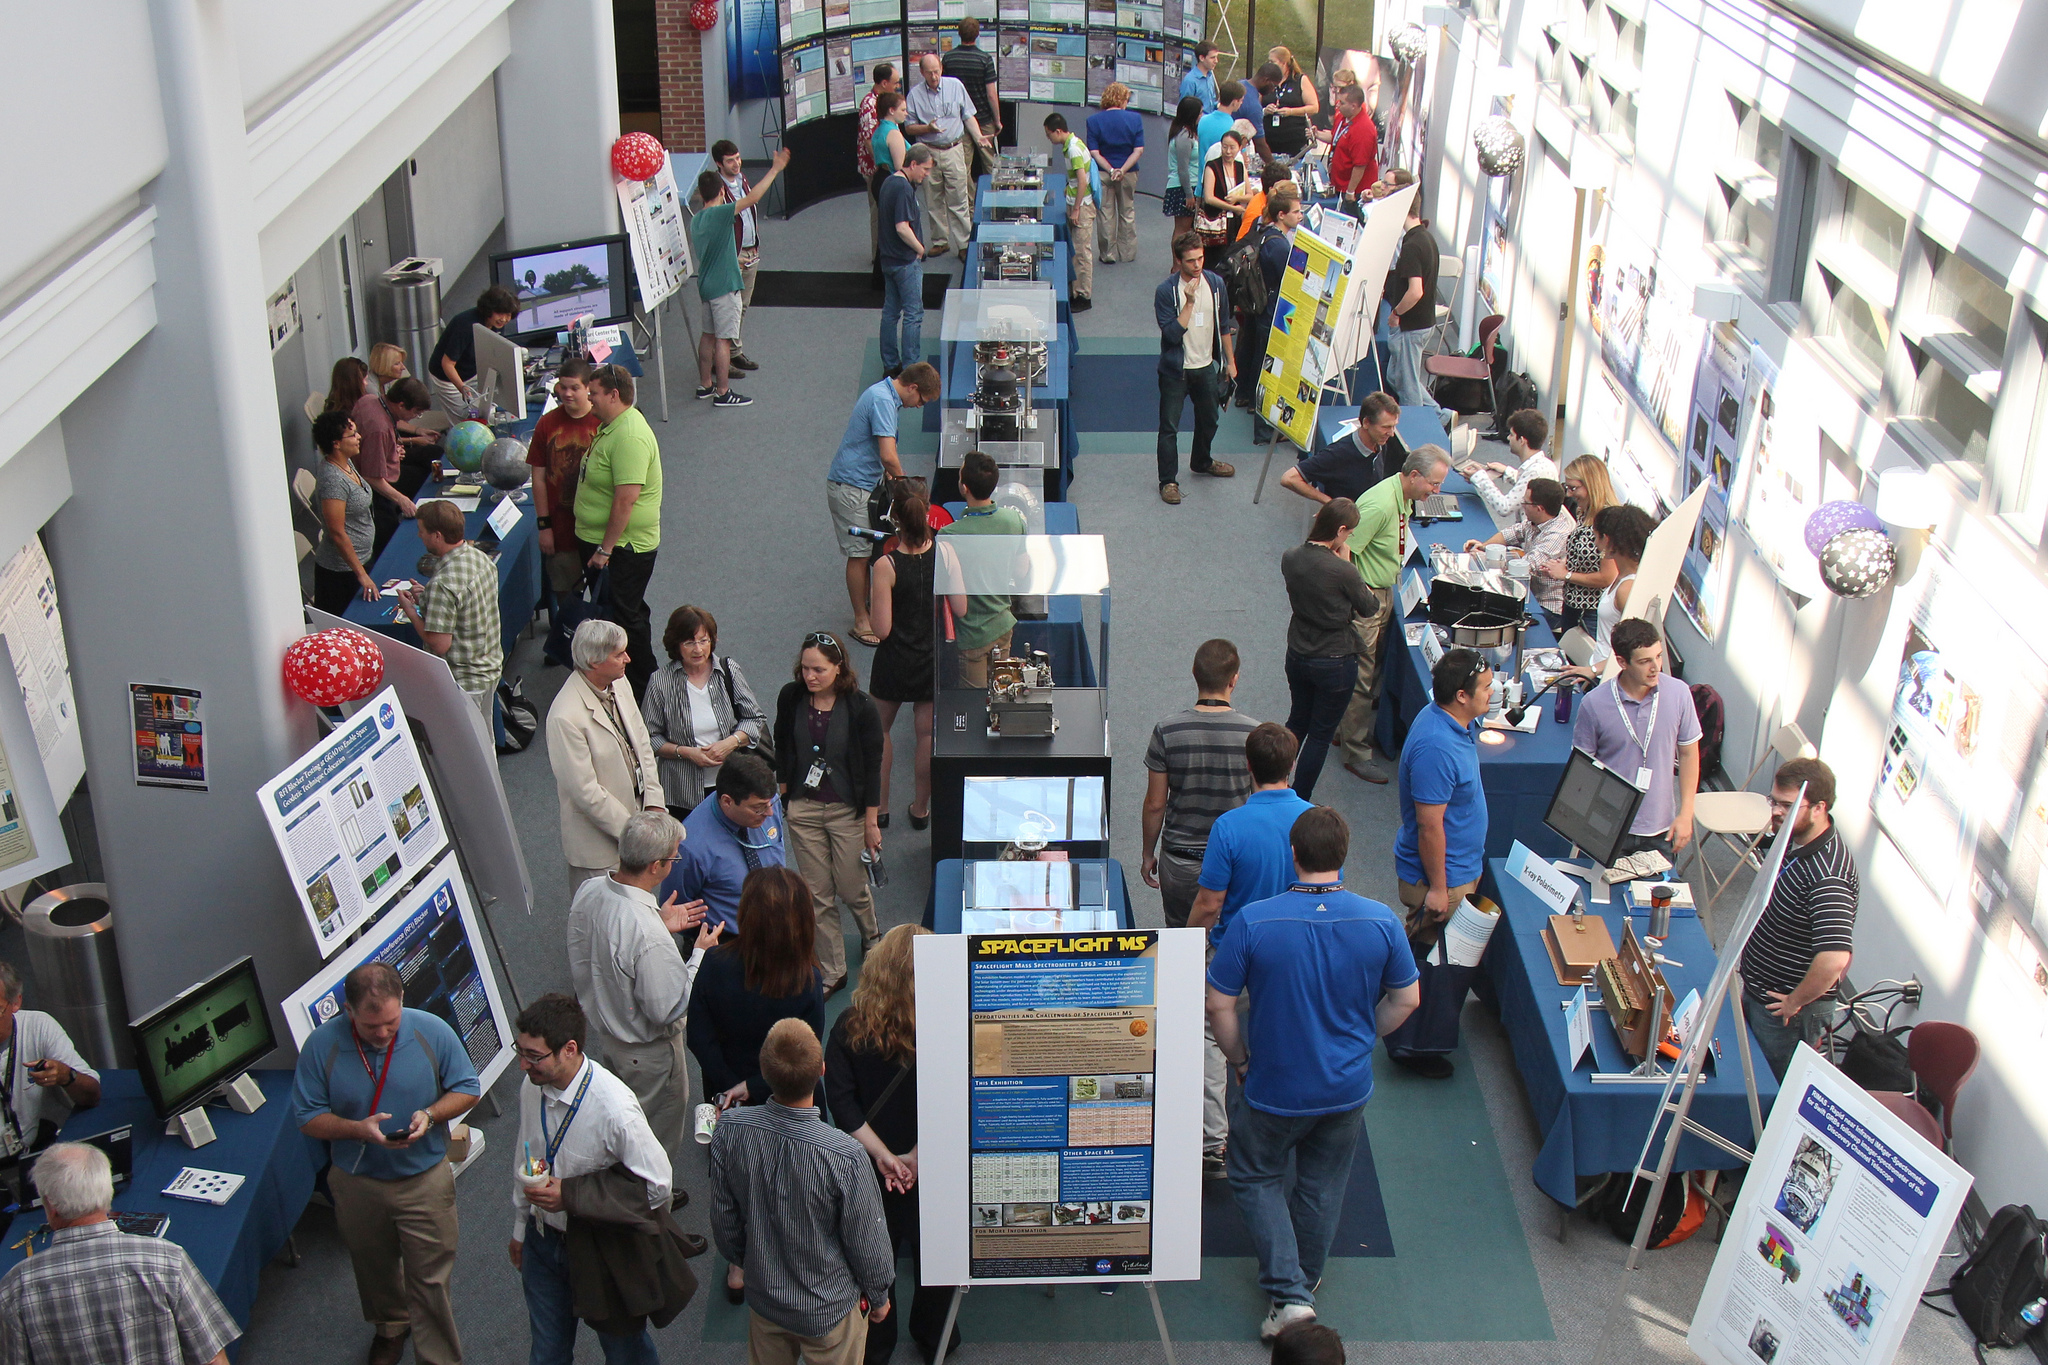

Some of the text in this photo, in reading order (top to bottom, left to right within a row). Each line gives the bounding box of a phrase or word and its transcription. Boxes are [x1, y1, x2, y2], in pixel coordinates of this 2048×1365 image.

[380, 710, 394, 724] NASA
[278, 785, 288, 798] RFI
[287, 775, 304, 791] Blocker
[303, 764, 322, 779] Testing
[343, 734, 358, 749] Enable
[356, 725, 368, 738] Space
[282, 790, 303, 808] Geodetic
[301, 772, 324, 792] Technique
[323, 755, 346, 776] Colocation
[1523, 865, 1566, 903] X-ray Polarimetry
[380, 909, 429, 957] Interference (RFI) Blocker
[979, 936, 1148, 954] SPACEFLIGHT MS
[1811, 1090, 1828, 1106] RIMAS
[1830, 1105, 1844, 1120] Rapid
[1843, 1116, 1856, 1127] near
[1855, 1122, 1875, 1144] Infrared
[1806, 1096, 1814, 1106] for
[1814, 1102, 1825, 1116] Swift
[1825, 1112, 1840, 1127] GRBs
[1840, 1123, 1861, 1144] followup
[1908, 1179, 1916, 1189] of
[1915, 1185, 1924, 1196] the
[1826, 1124, 1894, 1183] Discovery Channel Telescope
